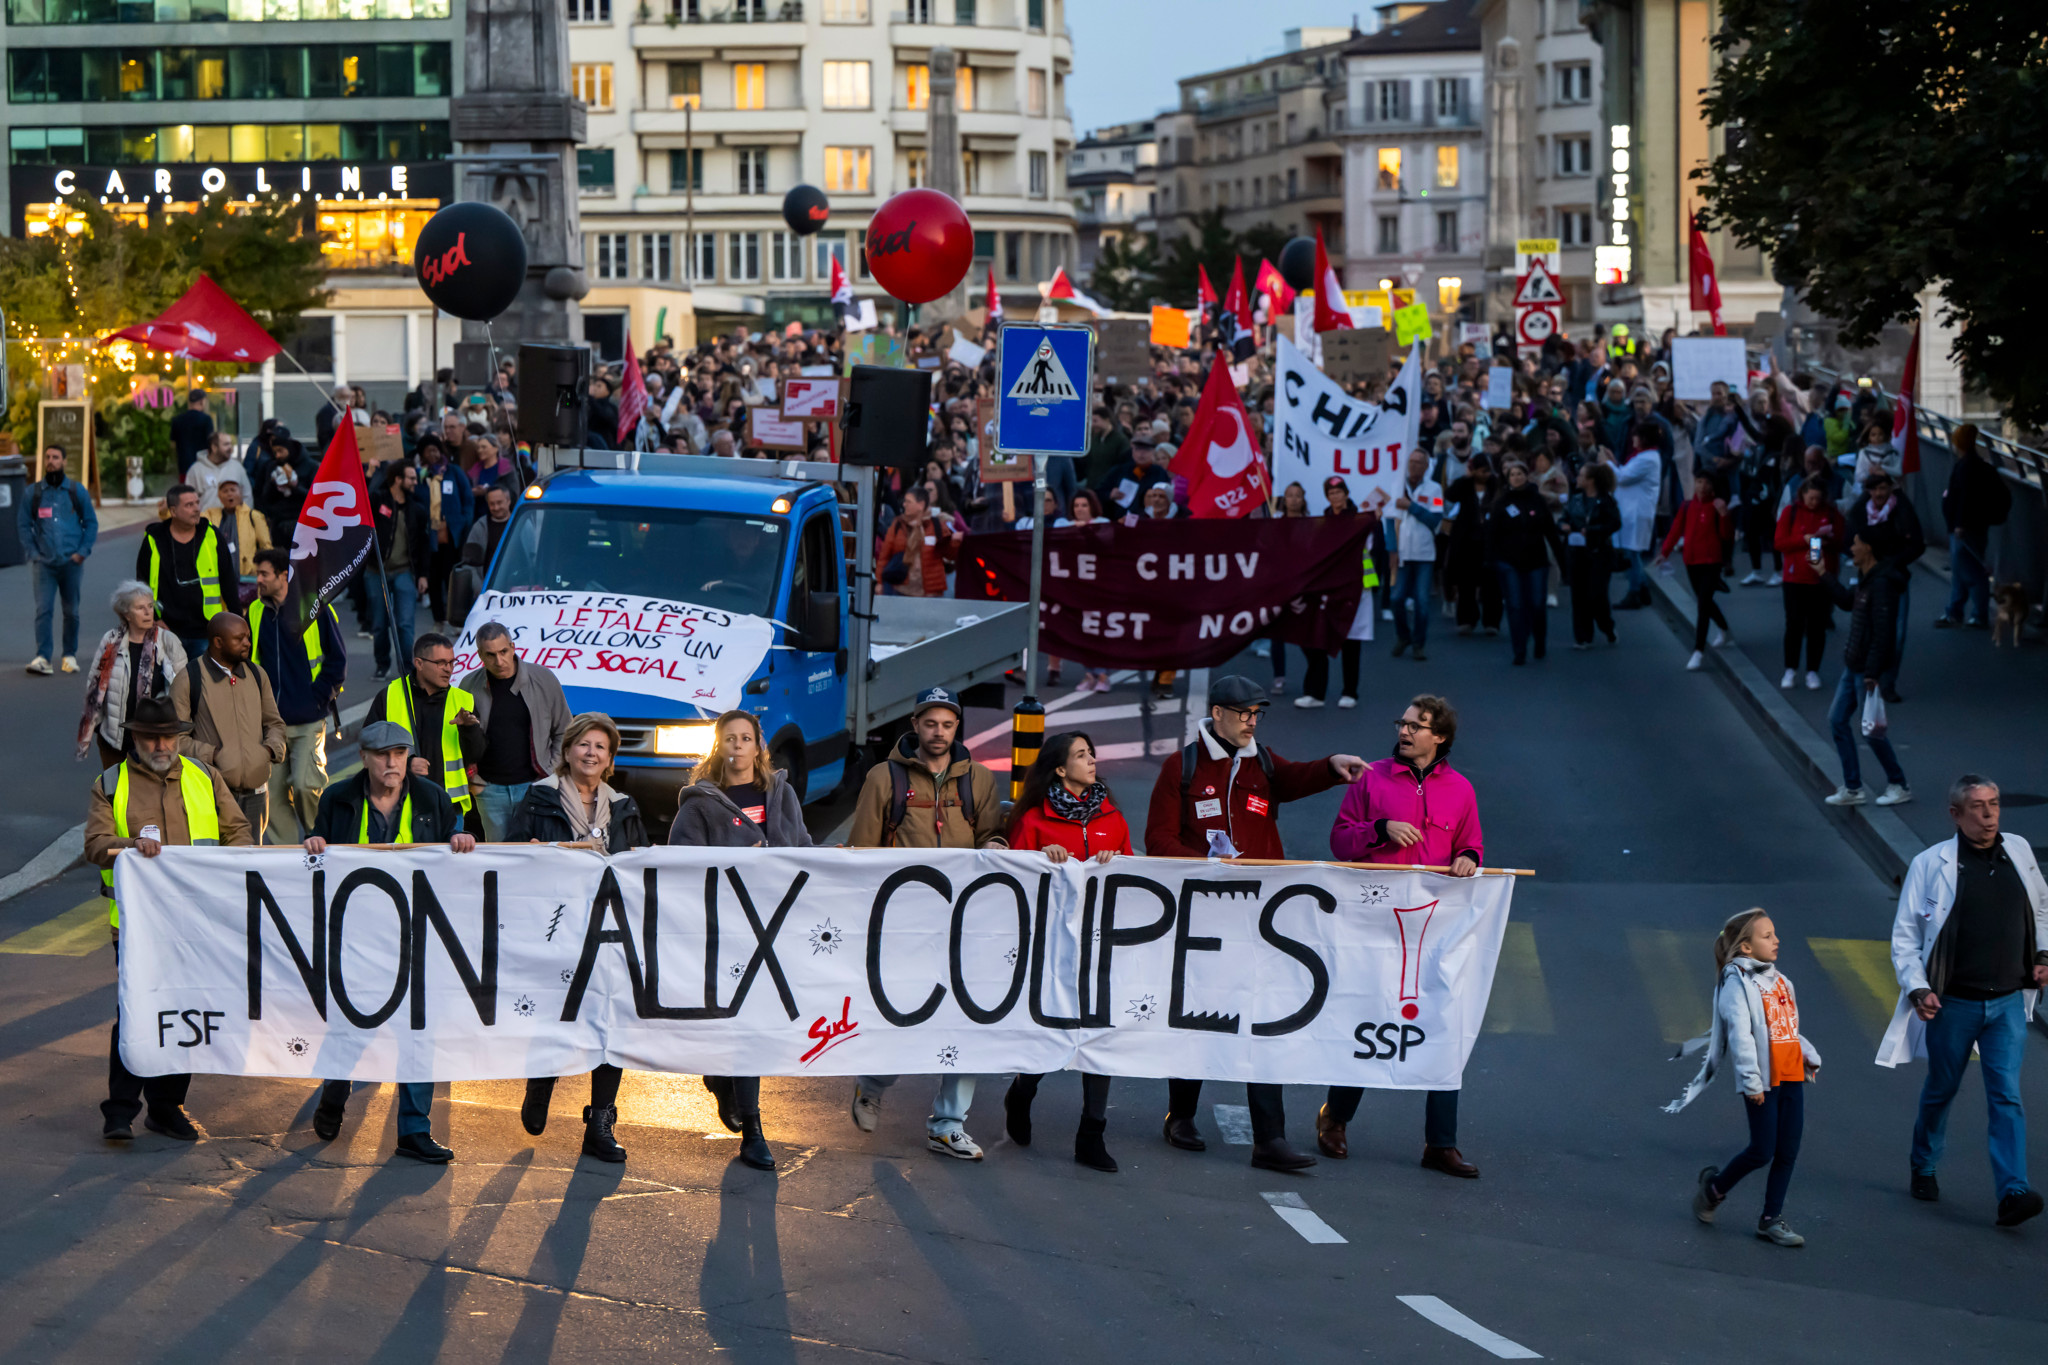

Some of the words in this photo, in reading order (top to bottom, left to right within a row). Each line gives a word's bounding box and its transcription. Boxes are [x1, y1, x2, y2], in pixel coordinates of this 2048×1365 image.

[54, 165, 409, 195] CAROLINE
[1611, 124, 1630, 245] HOTEL
[422, 232, 472, 288] Sud
[1285, 422, 1310, 466] EN
[1049, 551, 1097, 580] LE
[1136, 551, 1259, 581] CHUV
[460, 626, 528, 648] NS
[539, 627, 666, 649] VOULONS
[683, 639, 723, 660] UN
[691, 687, 717, 699] Sud
[246, 868, 499, 1030] NON
[560, 865, 810, 1022] AUX
[866, 865, 1337, 1036] COUPES
[1393, 899, 1440, 1019] !
[158, 1009, 225, 1048] FSF
[799, 995, 860, 1067] Sud
[1353, 1022, 1426, 1063] SSP
